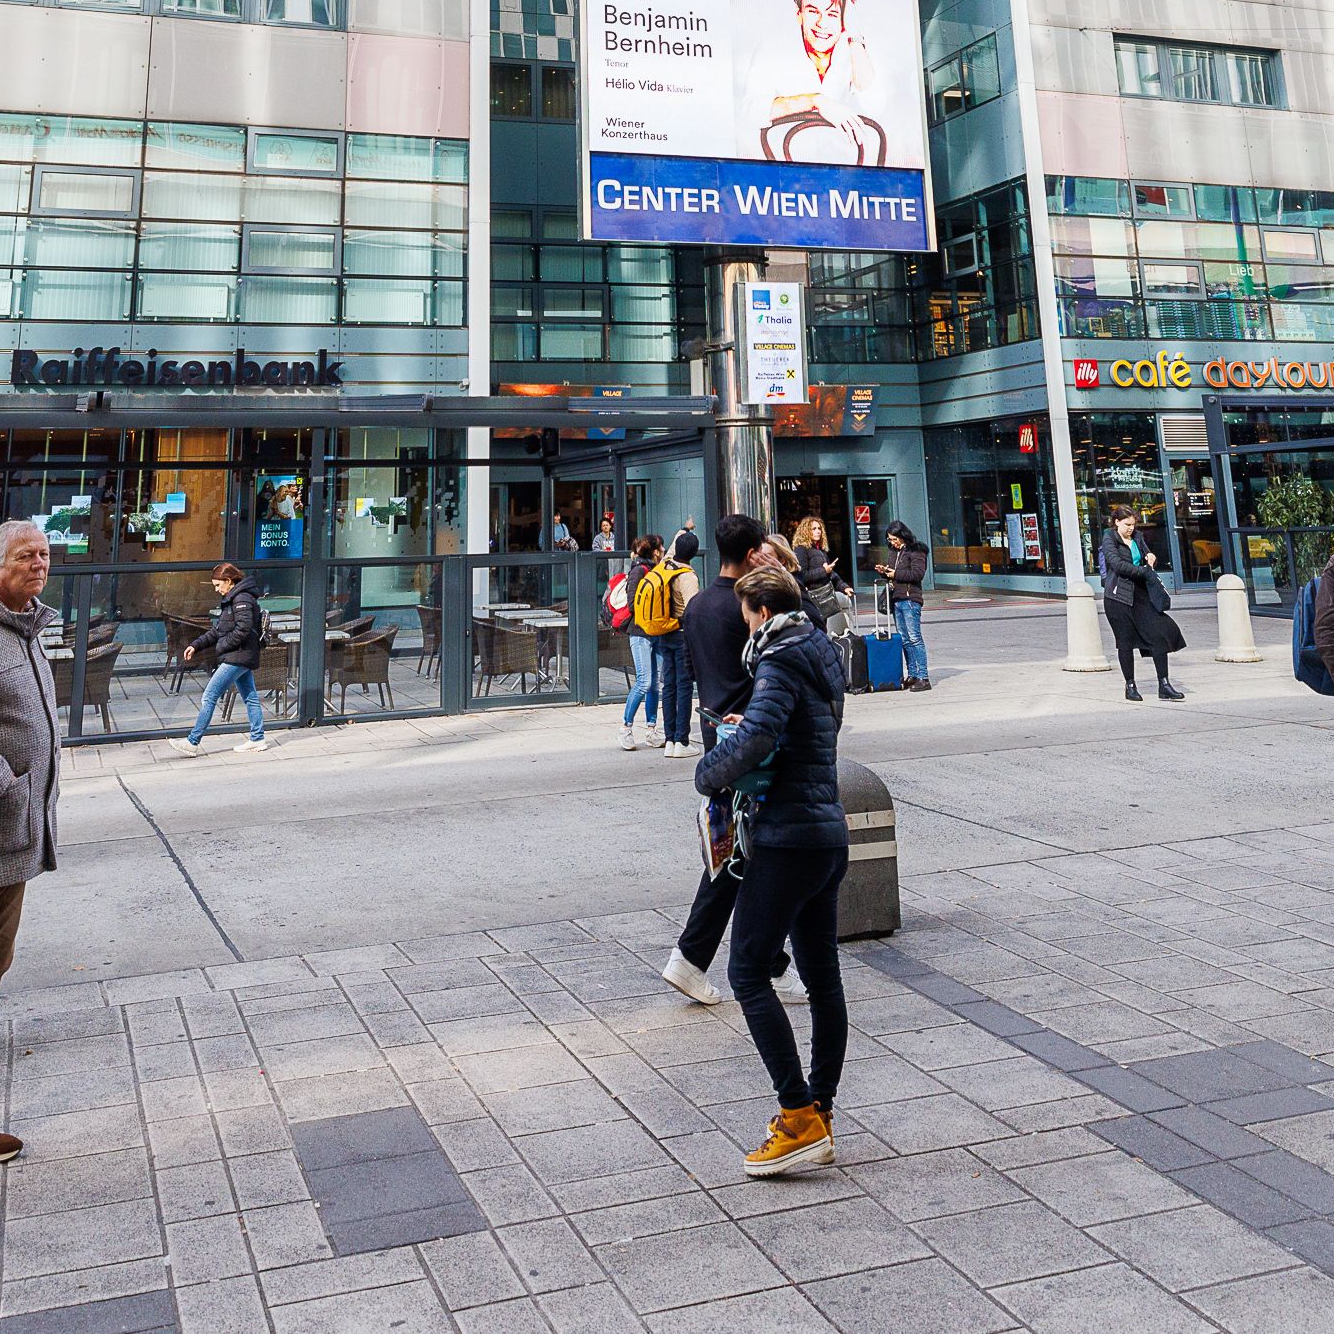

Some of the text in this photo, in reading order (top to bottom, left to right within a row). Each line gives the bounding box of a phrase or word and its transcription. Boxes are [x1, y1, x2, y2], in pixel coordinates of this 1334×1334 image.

[604, 4, 708, 32] Benjamin
[604, 30, 712, 58] Bernheim
[605, 59, 629, 68] Tenor
[605, 78, 635, 90] Hélio
[638, 80, 664, 92] Vida
[605, 117, 645, 128] Wiener
[601, 128, 668, 141] Konzerthaus
[597, 179, 918, 222] CENTER WIEN MITTE
[765, 316, 792, 324] Thalia
[11, 347, 345, 387] Raiffeisenbank
[1077, 362, 1098, 384] illy
[1110, 350, 1192, 389] café
[769, 383, 784, 393] dm
[1020, 427, 1033, 450] illy
[261, 523, 281, 531] MEIN
[261, 531, 289, 540] BONUS
[260, 539, 290, 548] KONTO.
